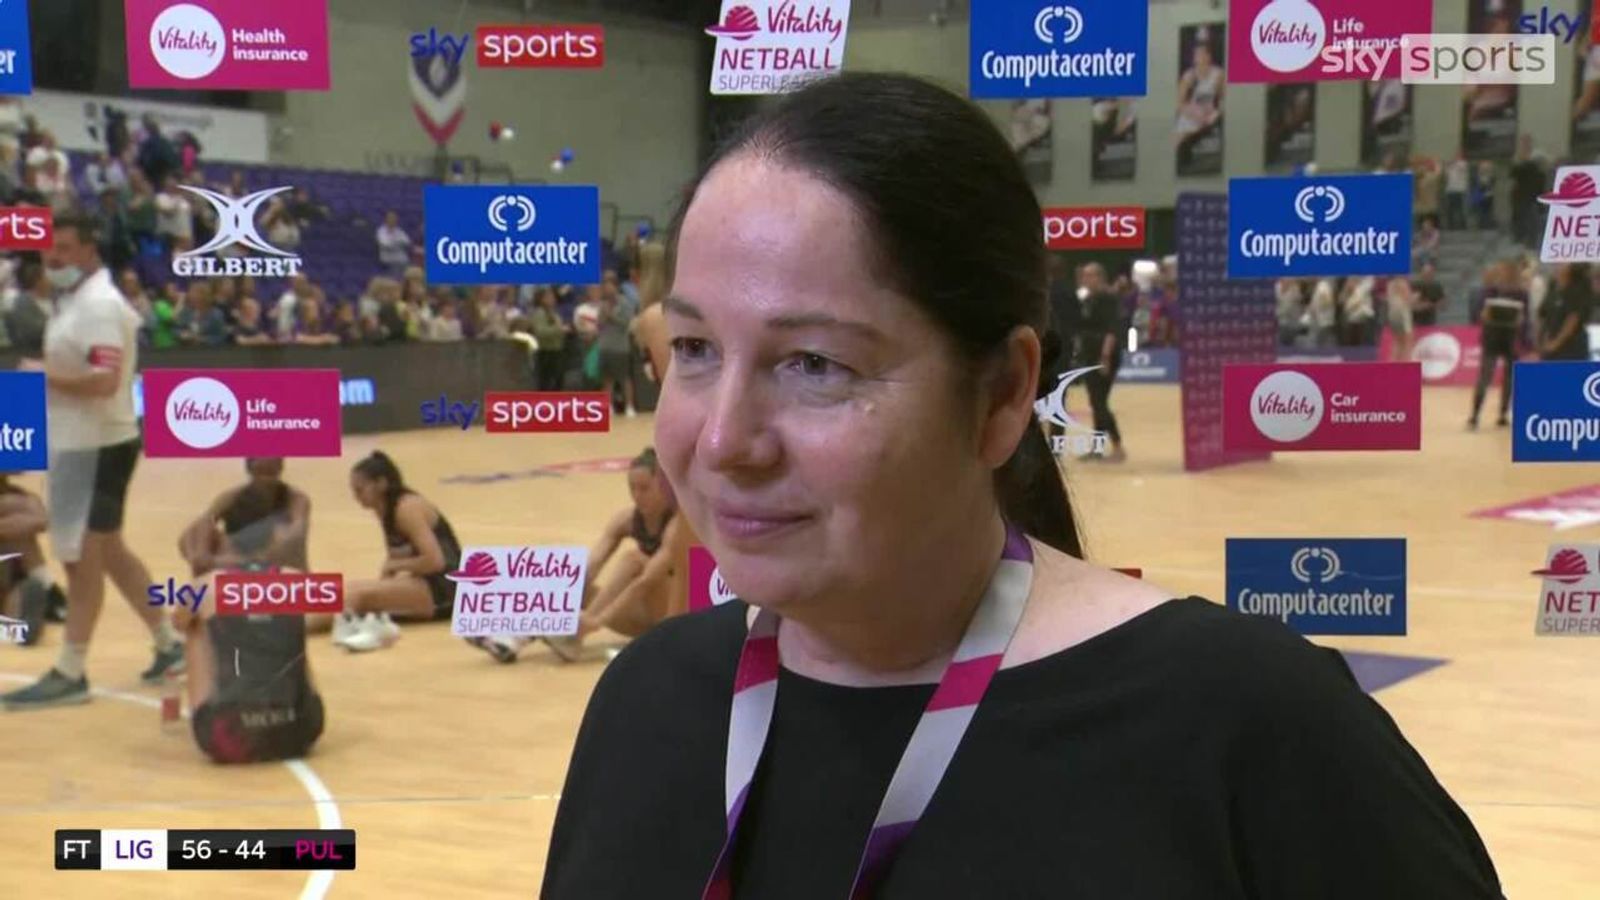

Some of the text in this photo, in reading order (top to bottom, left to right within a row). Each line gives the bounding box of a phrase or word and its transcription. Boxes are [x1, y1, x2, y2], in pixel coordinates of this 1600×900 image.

[232, 28, 285, 43] Health
[767, 0, 842, 43] Vitality
[1258, 20, 1318, 49] Vitality
[1333, 17, 1365, 33] Life
[1519, 6, 1582, 43] sky
[158, 27, 217, 57] Vitality
[233, 46, 309, 61] insurance
[409, 27, 597, 63] sky sports
[719, 48, 837, 70] NETBALL
[981, 49, 1136, 86] Computacenter
[1043, 212, 1137, 245] ports
[436, 237, 588, 273] Computacenter
[1240, 229, 1400, 266] Computacenter
[172, 257, 302, 277] GILBERT
[173, 398, 232, 428] Vitality
[246, 399, 277, 414] Life
[420, 395, 604, 430] sky sports
[1258, 391, 1316, 420] Vitality
[1330, 393, 1360, 407] Car
[246, 416, 321, 430] insurance
[1330, 409, 1406, 423] insurance
[0, 422, 35, 451] ter
[1525, 413, 1600, 451] Compu
[507, 547, 582, 586] Vitality
[147, 577, 337, 613] sky sports
[459, 592, 575, 614] NETBALL
[1237, 588, 1395, 624] Computacenter
[457, 616, 573, 633] SUPERLEAGUE
